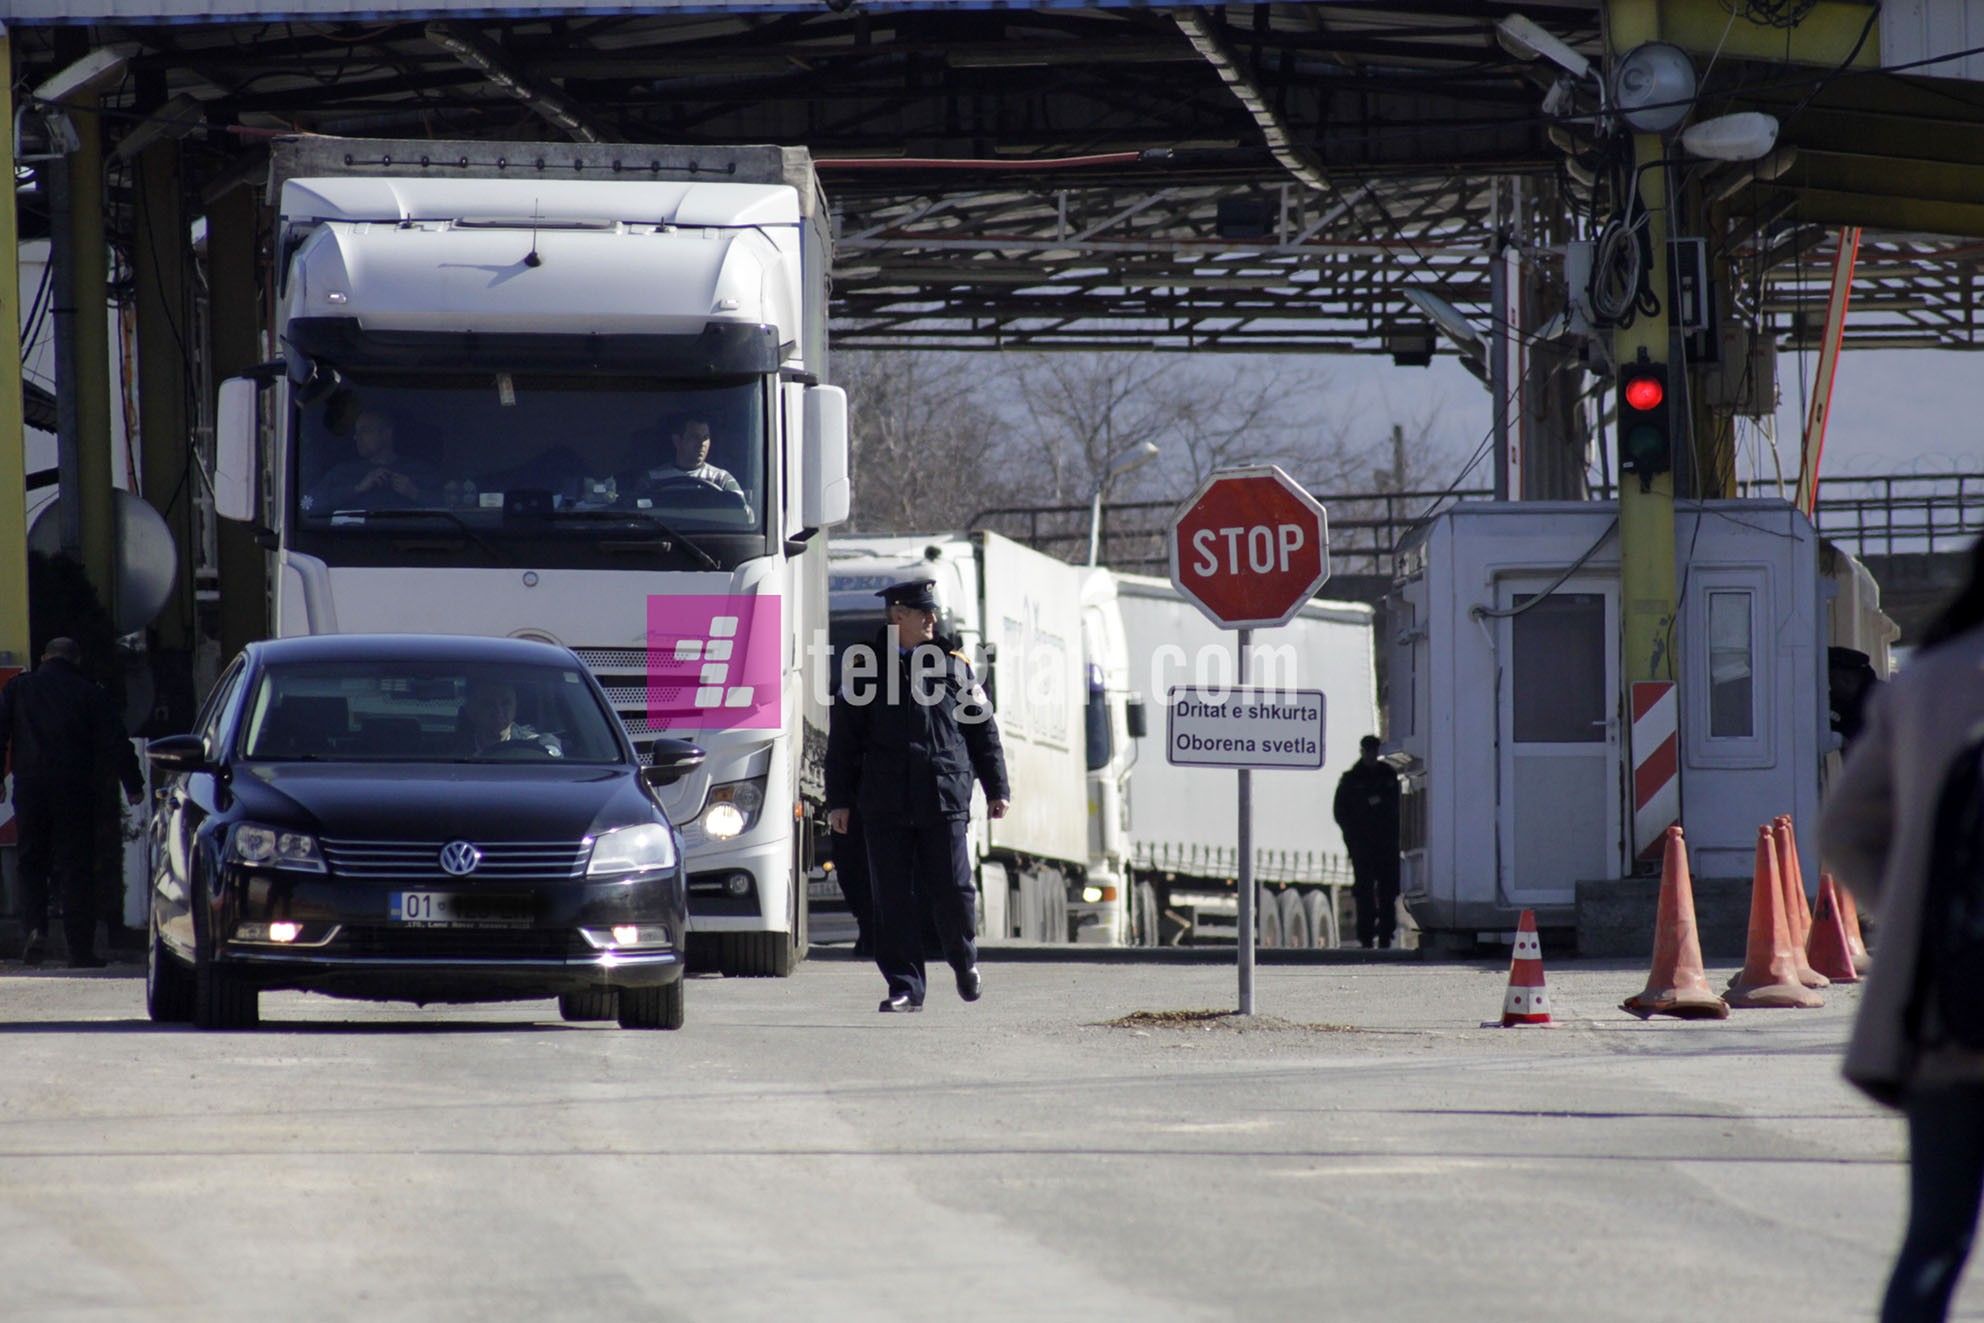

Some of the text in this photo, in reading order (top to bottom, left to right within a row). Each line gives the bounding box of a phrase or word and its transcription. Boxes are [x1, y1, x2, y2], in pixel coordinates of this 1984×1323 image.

[1192, 523, 1305, 578] STOP
[1176, 700, 1318, 722] Dritat e shkurta
[1176, 733, 1317, 754] Oborena svetla
